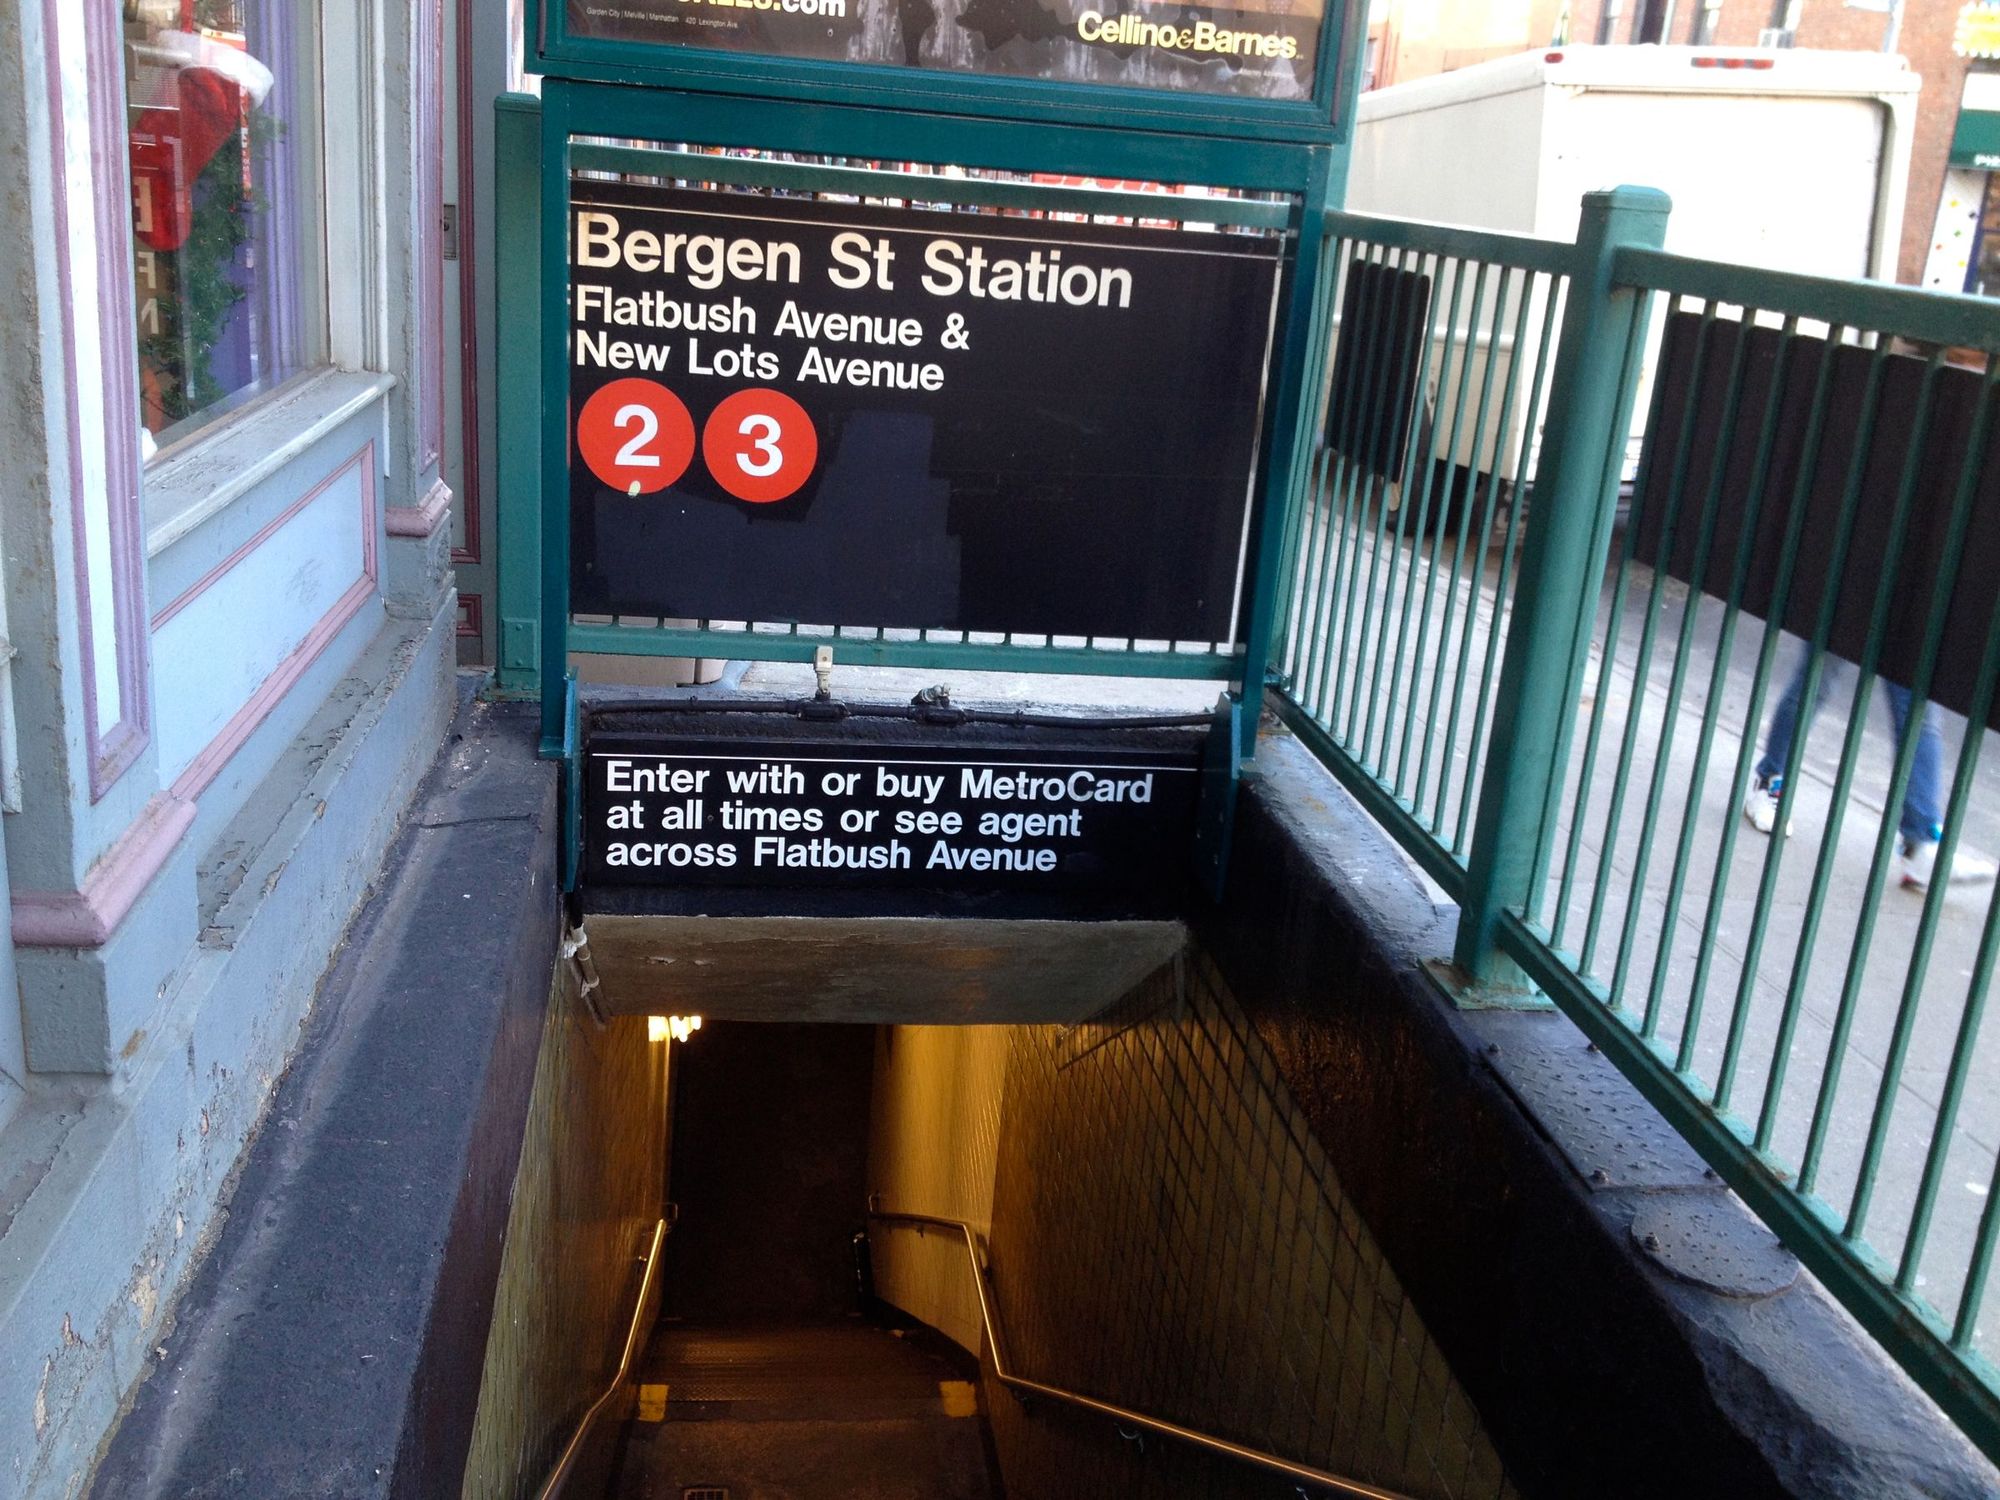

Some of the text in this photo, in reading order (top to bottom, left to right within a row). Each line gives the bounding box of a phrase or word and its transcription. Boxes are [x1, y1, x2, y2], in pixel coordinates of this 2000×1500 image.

[586, 7, 608, 16] Garden
[608, 8, 621, 18] City
[624, 11, 646, 20] Melville
[649, 13, 679, 23] Manhattan
[685, 17, 697, 25] 420
[698, 19, 727, 28] Lexington
[1077, 9, 1298, 59] Cellino&Barnes
[576, 210, 1133, 308] Bergen St Station
[576, 284, 970, 351] Flatbush Avenue &
[576, 329, 945, 391] New Lots Avenue
[613, 403, 784, 477] 2 3
[606, 760, 1153, 804] Enter with or buy MetroCard
[606, 799, 1082, 841] at all times or see agent
[605, 835, 1057, 872] across Flatbush Avenue
